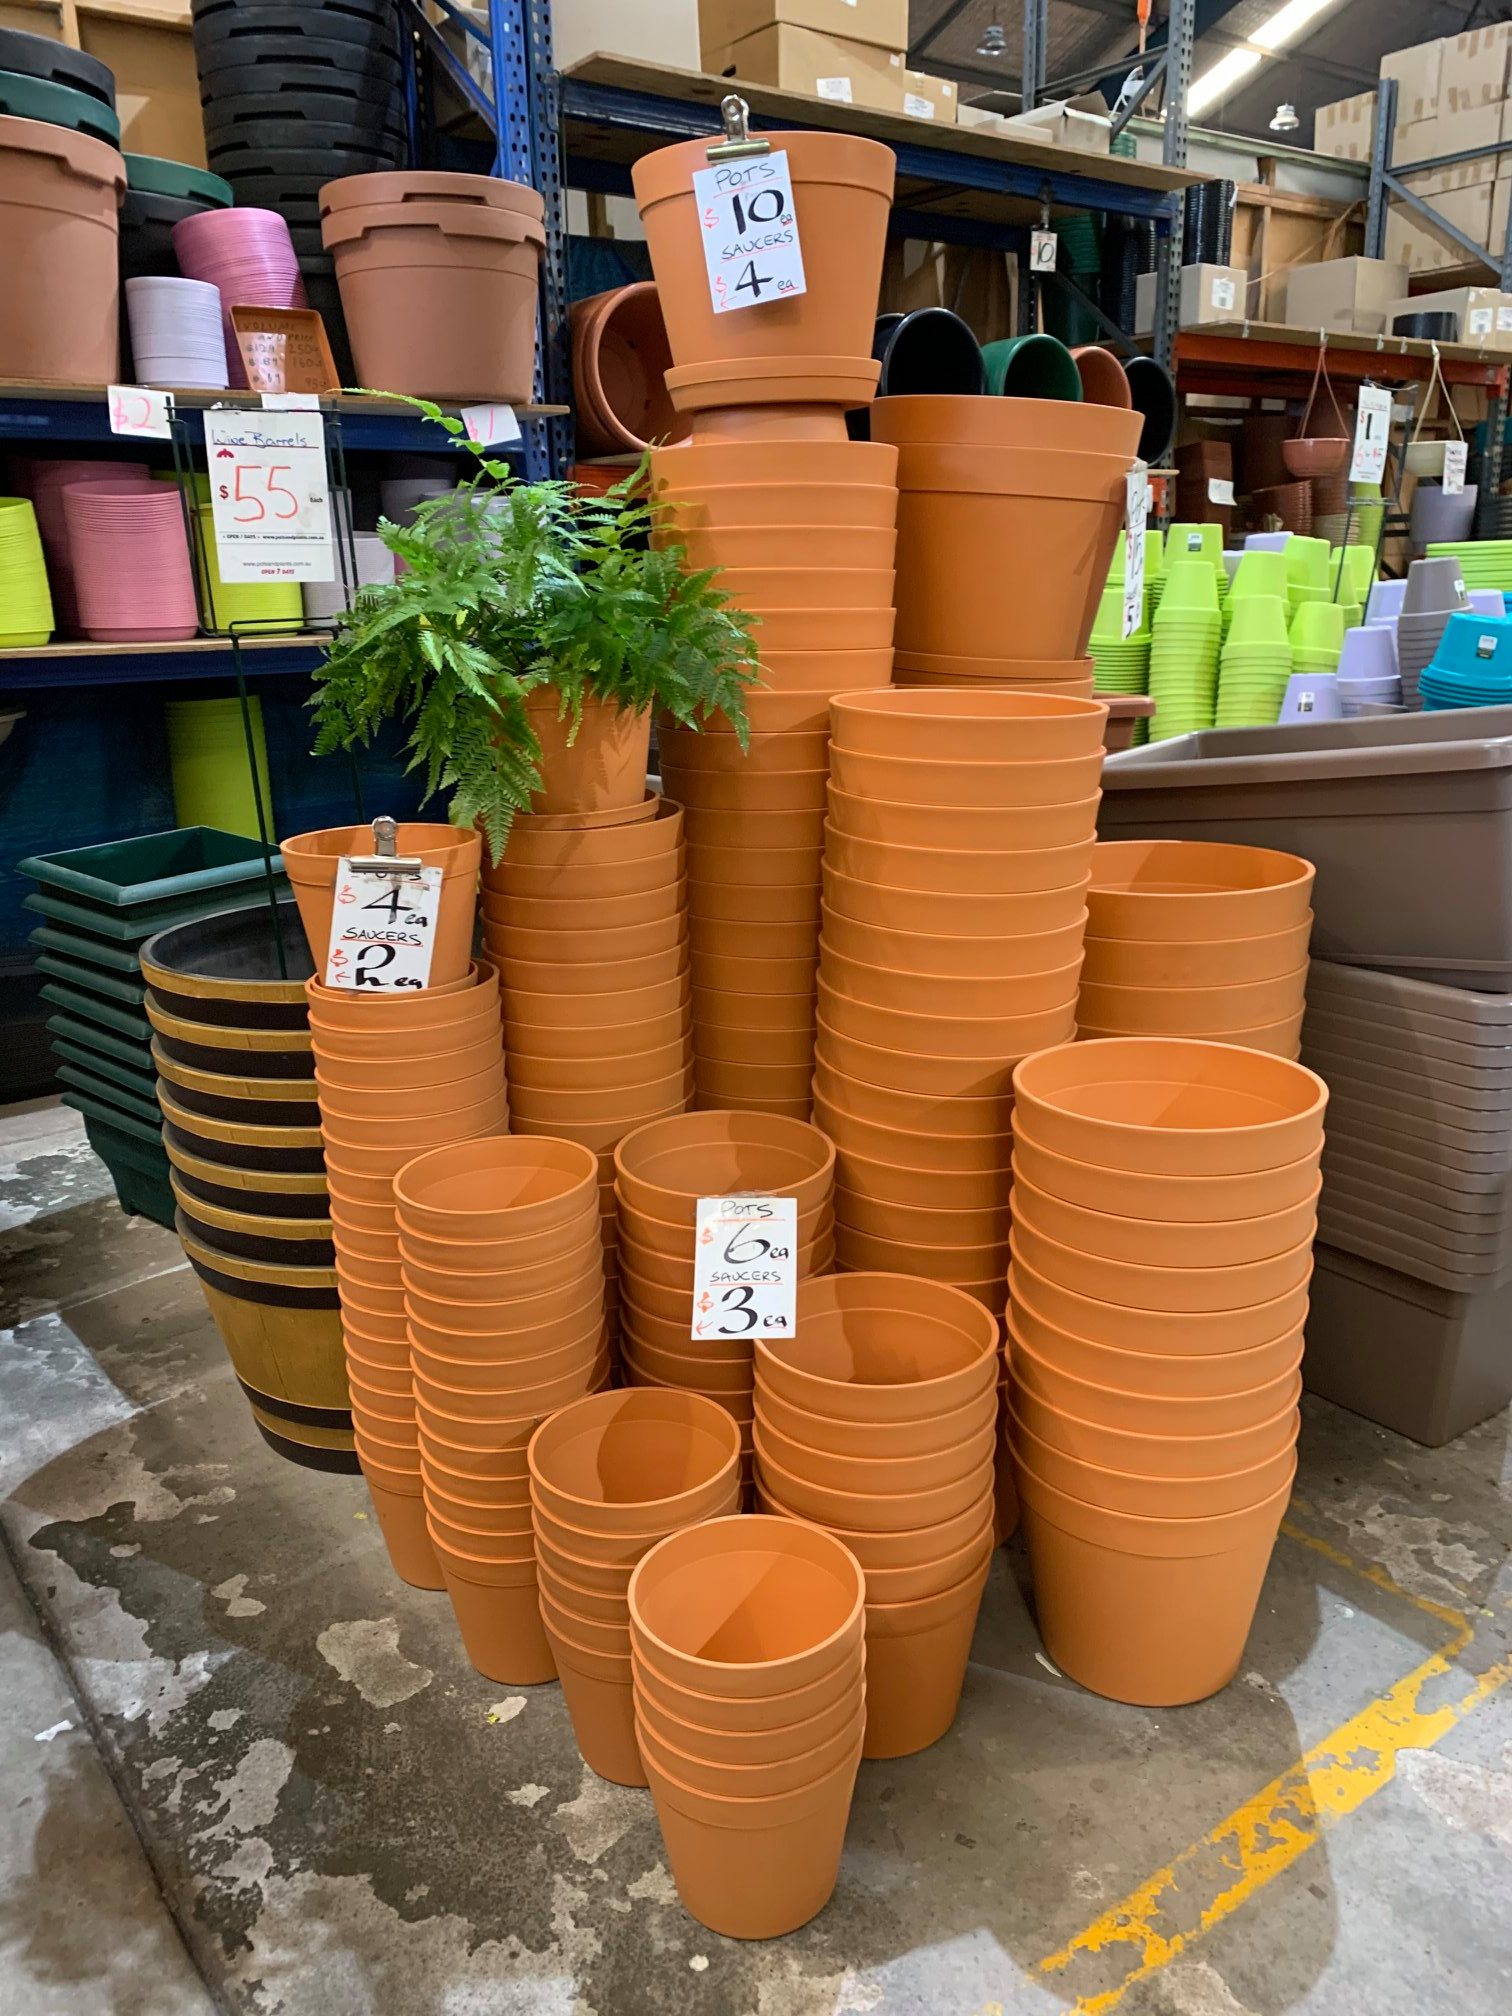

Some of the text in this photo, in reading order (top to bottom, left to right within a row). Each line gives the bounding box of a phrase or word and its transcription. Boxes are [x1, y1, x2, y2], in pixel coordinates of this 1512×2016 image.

[715, 162, 775, 191] POTS
[721, 229, 793, 260] SAUCERS
[112, 396, 156, 431] $2
[245, 431, 308, 449] Barrels
[404, 914, 428, 927] ea
[342, 927, 422, 946] SAUCERS
[394, 977, 422, 990] ea
[721, 1200, 773, 1218] POTS
[769, 1247, 789, 1259] ea
[710, 1271, 781, 1282] SAUCERS
[763, 1315, 788, 1328] ea
